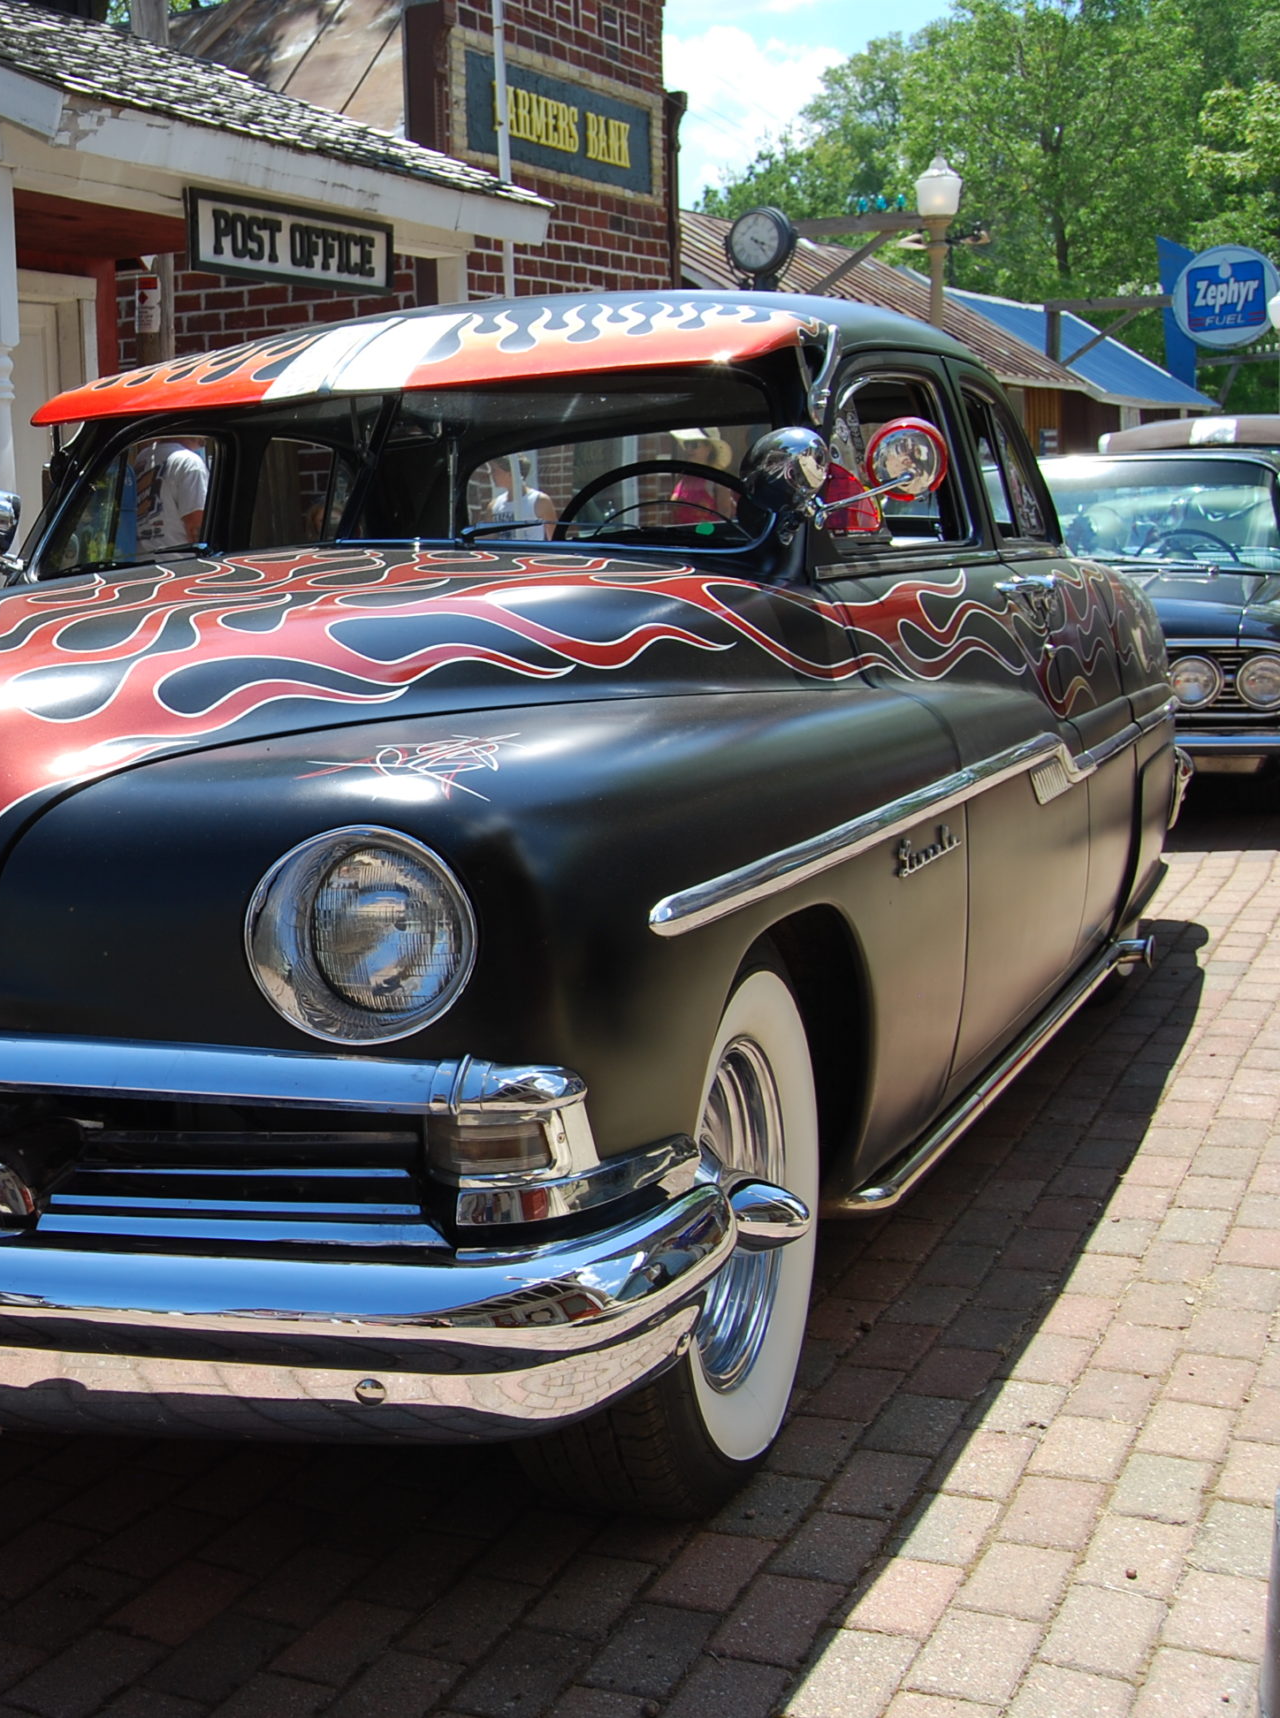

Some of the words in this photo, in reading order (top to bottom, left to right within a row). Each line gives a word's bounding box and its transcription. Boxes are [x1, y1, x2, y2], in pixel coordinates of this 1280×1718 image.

[586, 111, 631, 168] BANK
[212, 208, 282, 263] POST
[289, 223, 375, 278] OFFICE
[1194, 277, 1259, 313] Zephyr
[1205, 313, 1245, 327] FUEL
